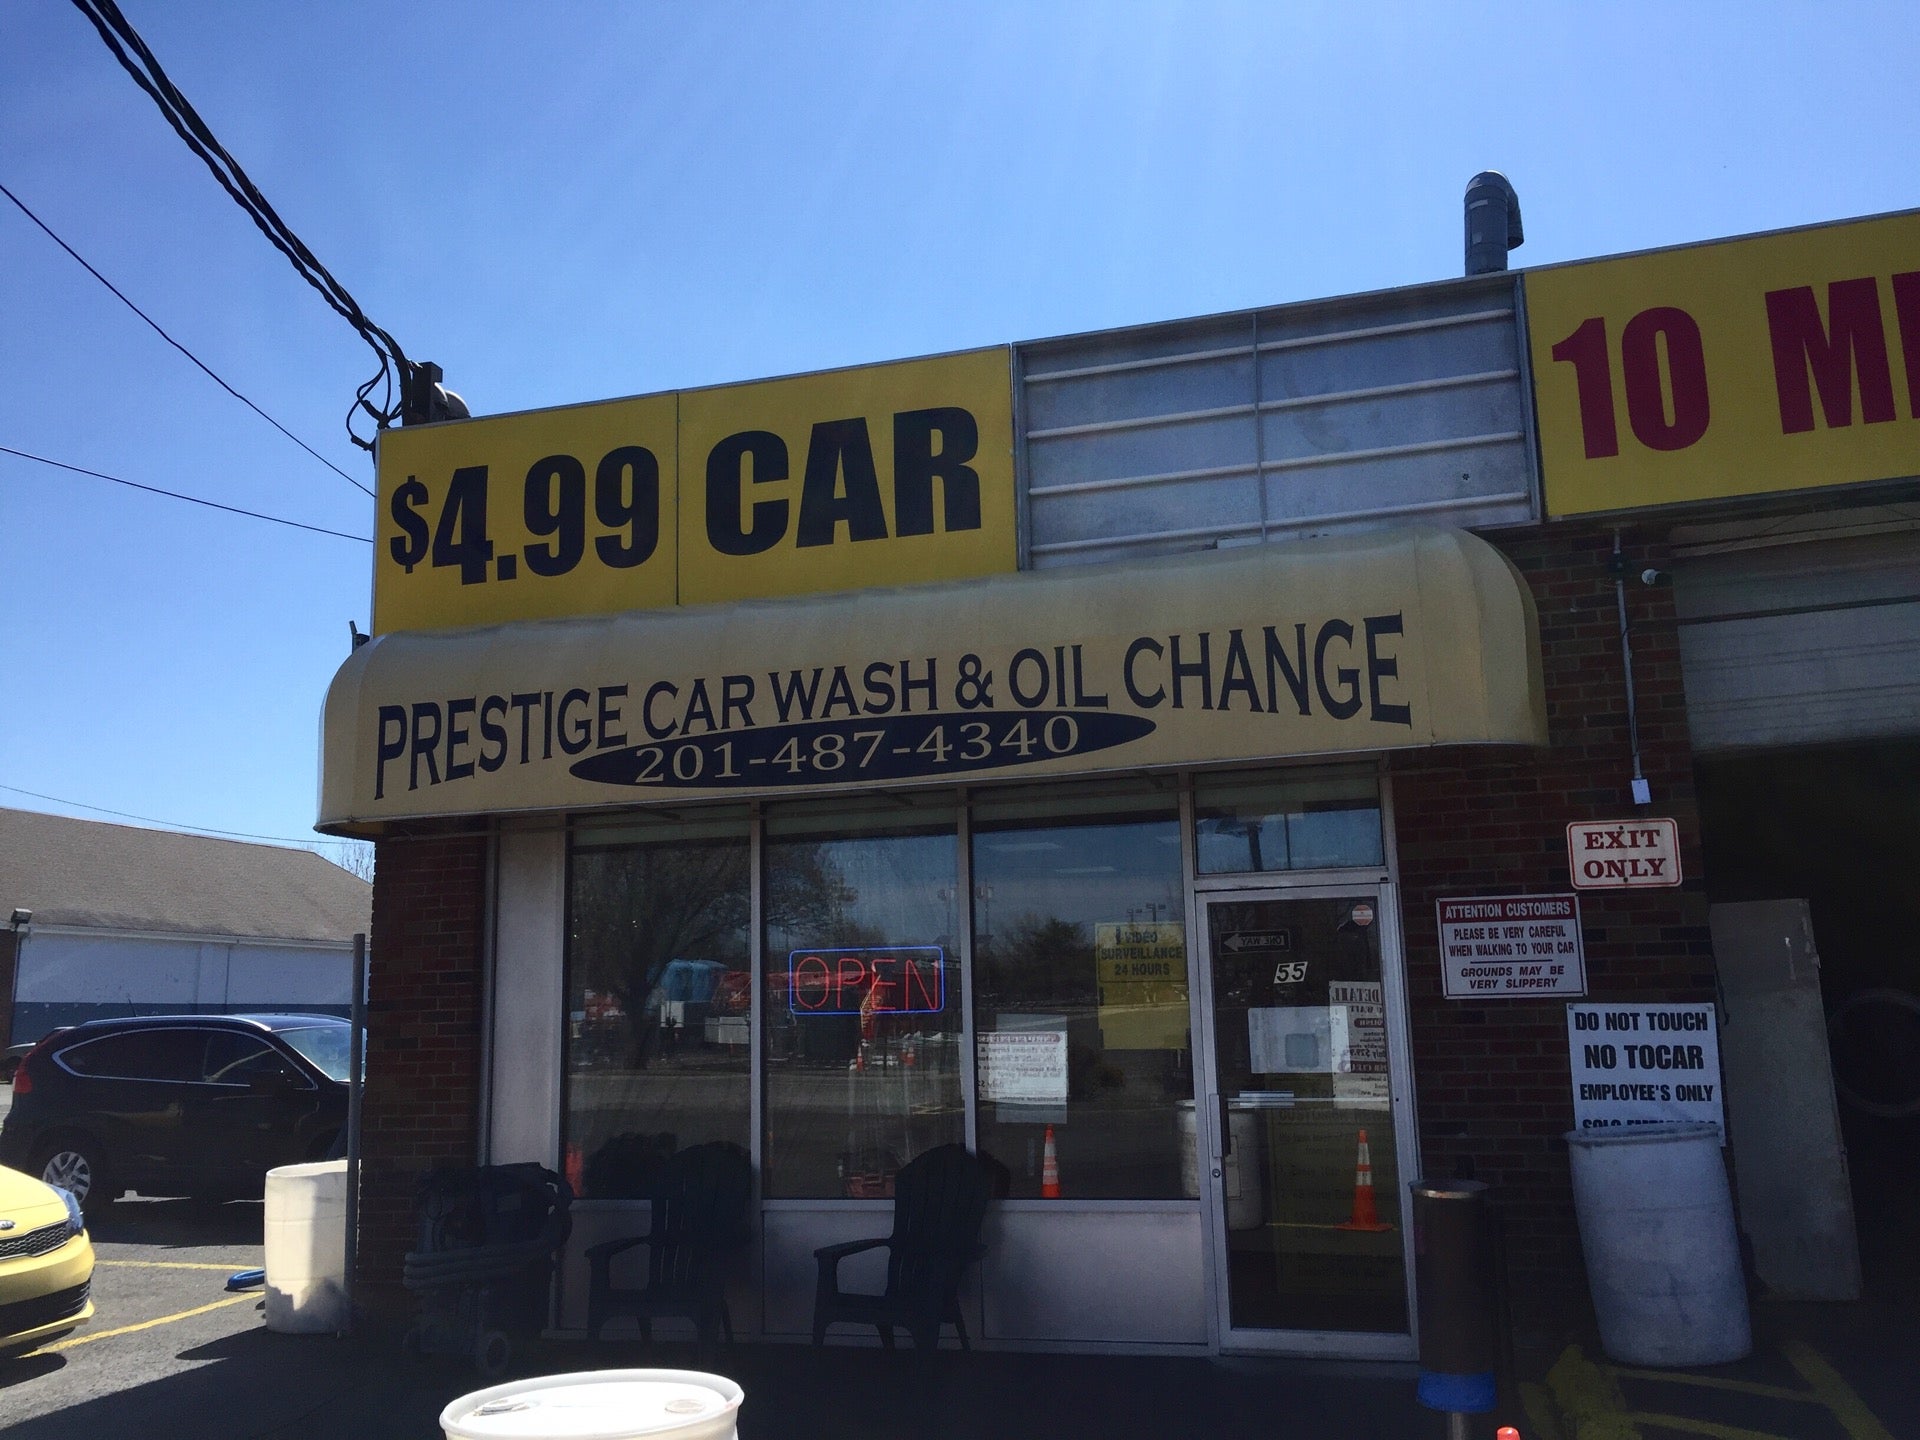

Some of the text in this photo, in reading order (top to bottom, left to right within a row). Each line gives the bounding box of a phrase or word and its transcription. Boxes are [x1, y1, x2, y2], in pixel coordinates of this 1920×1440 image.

[1552, 306, 1710, 459] 10
[390, 406, 982, 585] $4.99 CAR
[374, 610, 1412, 800] PRESTIGE CAR WASH & OIL CHANGE
[634, 715, 1080, 783] 201-487-4340
[1583, 829, 1660, 850] EXIT
[1583, 858, 1667, 879] ONLY
[1445, 901, 1571, 919] ATTENTION CUSTOMERS
[1125, 931, 1158, 944] VIDEO
[1454, 925, 1566, 940] PLEASE BE VERY CAREFUL
[1101, 946, 1183, 960] SURVEILLANCE
[1449, 942, 1574, 957] WHEN WALKING TO YOUR CAR
[1114, 963, 1170, 976] 24 HOURS
[1276, 963, 1306, 982] 55
[1461, 965, 1565, 978] GROUNDS MAY BE
[795, 956, 940, 1011] OPEN
[1469, 977, 1558, 989] VERY SLIPPERY
[1575, 1012, 1708, 1031] DO NOT TOUCH
[1585, 1045, 1705, 1070] NO TOCAR
[1580, 1084, 1714, 1102] EMPLOYEE'S ONLY
